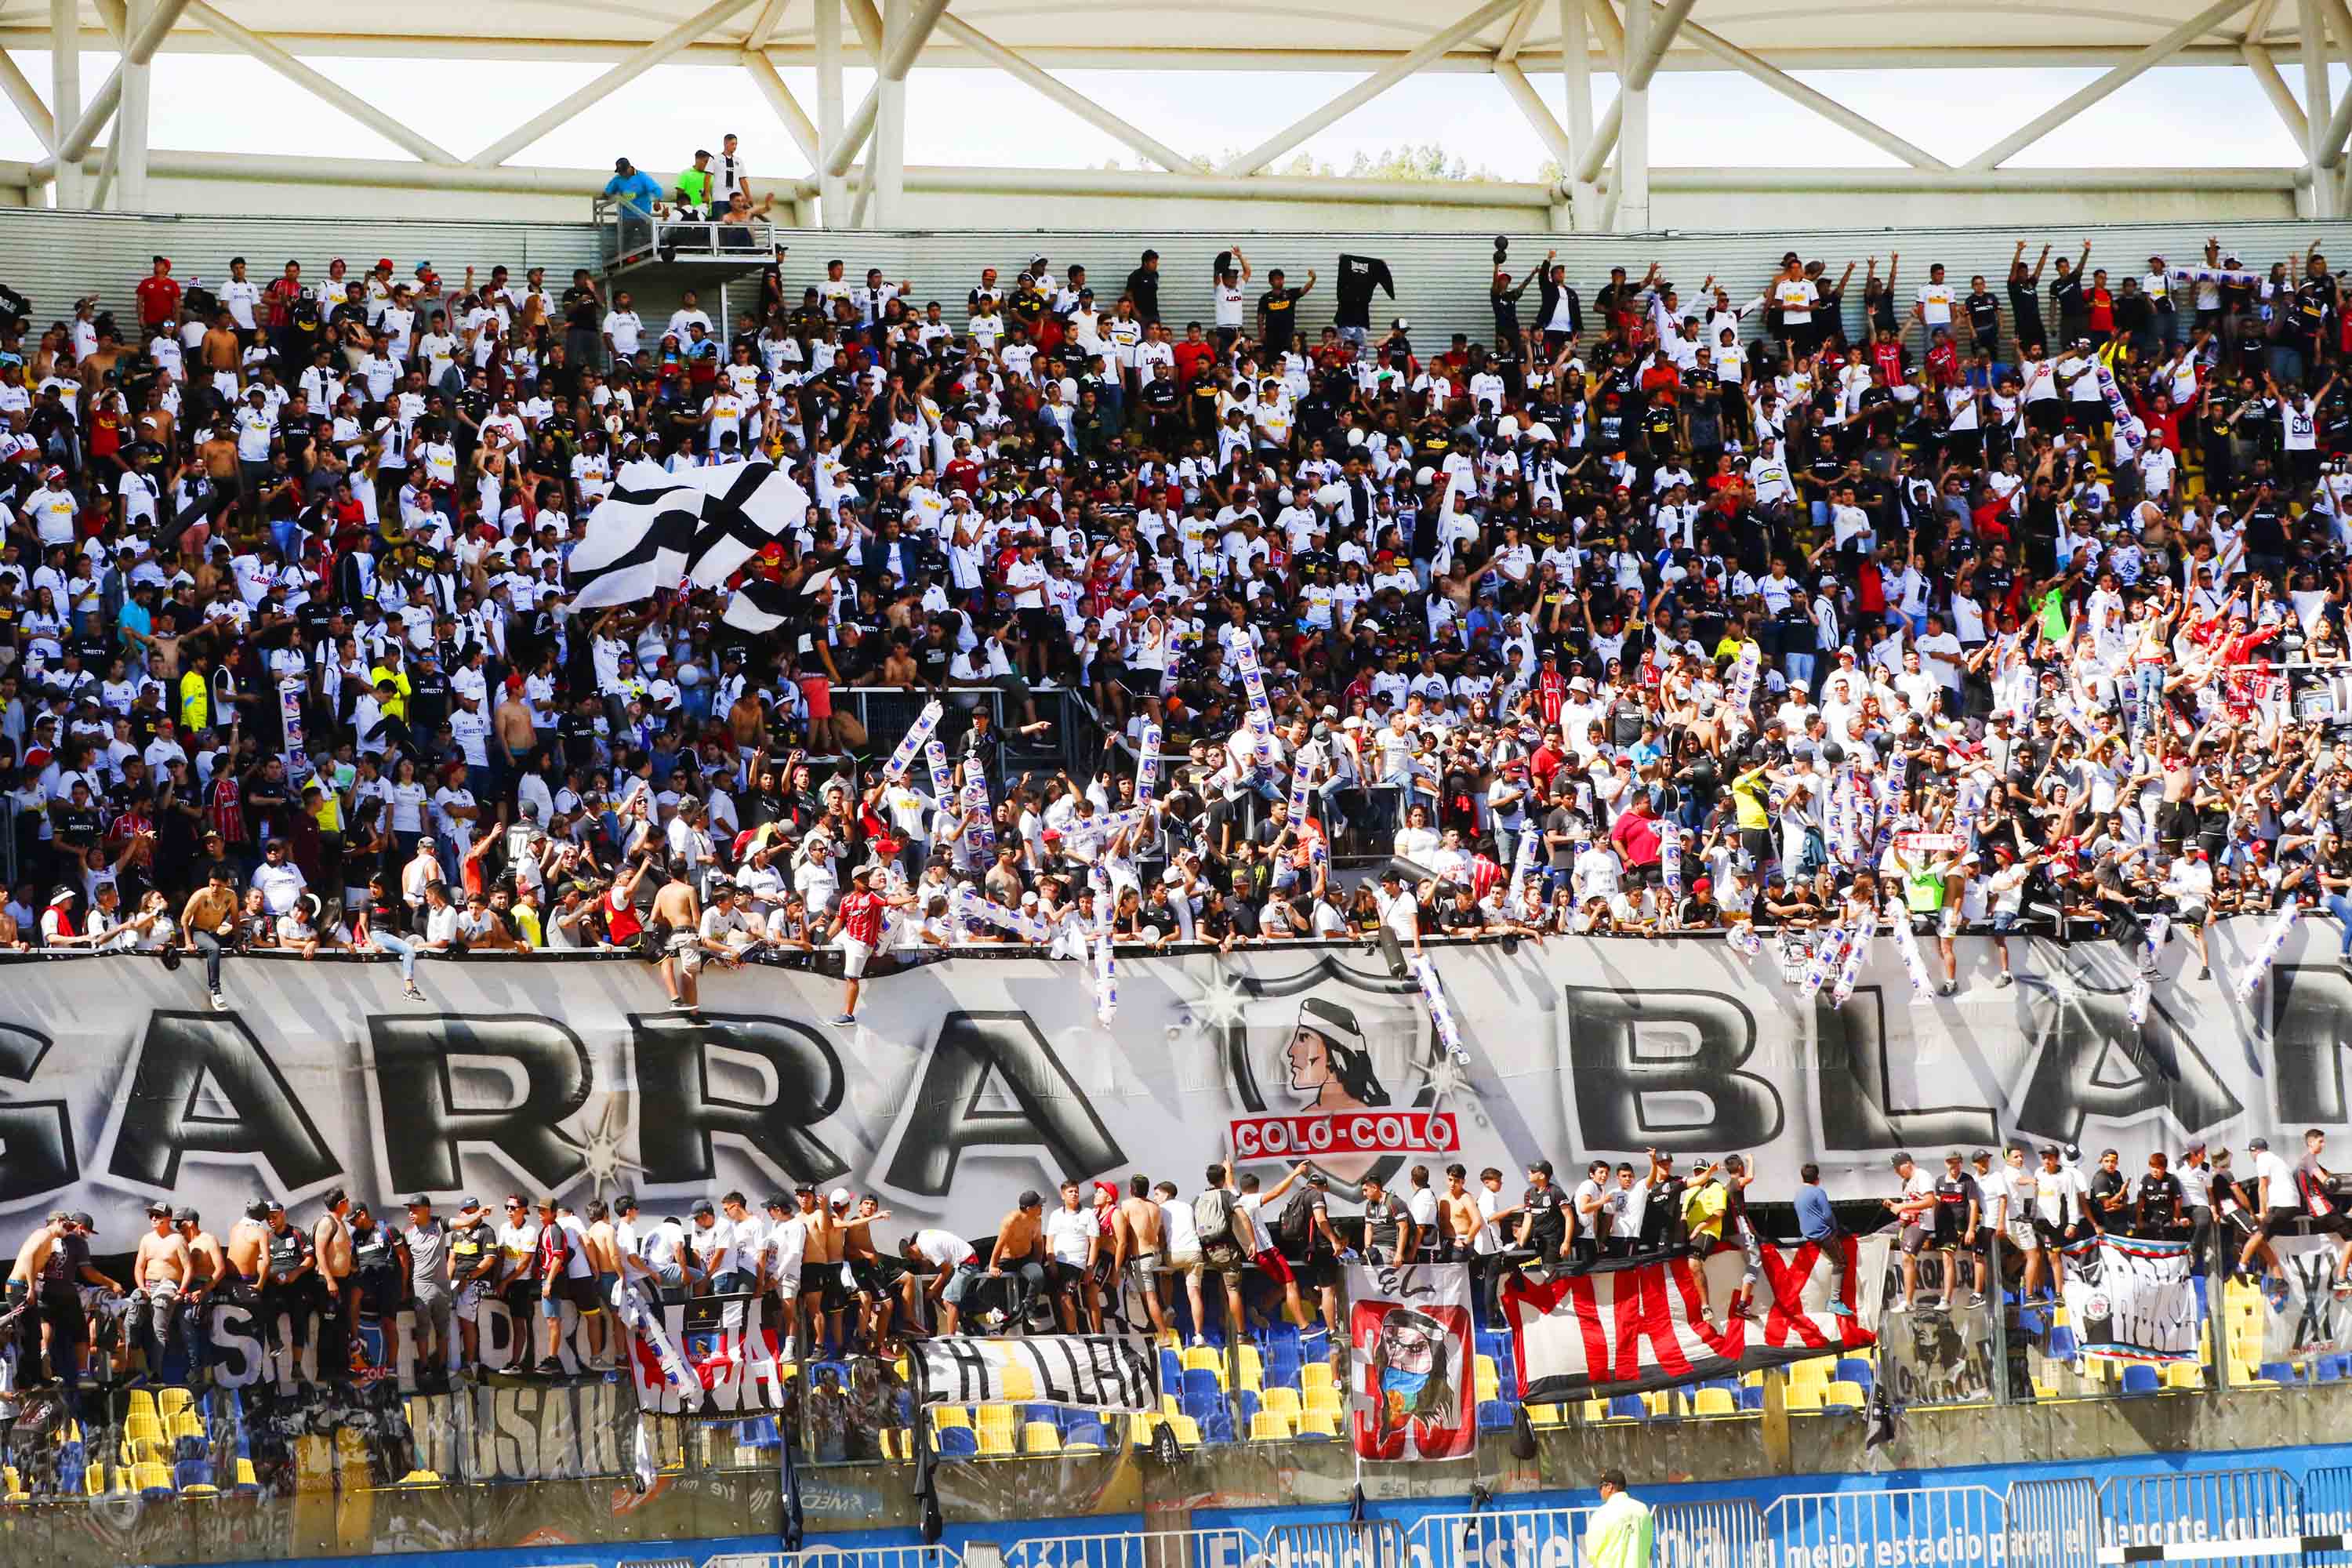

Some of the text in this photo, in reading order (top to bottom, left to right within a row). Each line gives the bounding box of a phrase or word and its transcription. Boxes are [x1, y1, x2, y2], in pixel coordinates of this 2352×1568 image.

[1236, 1115, 1451, 1156] COLO-COLO
[1786, 1534, 1870, 1568] mejor
[1878, 1527, 1974, 1566] estadio
